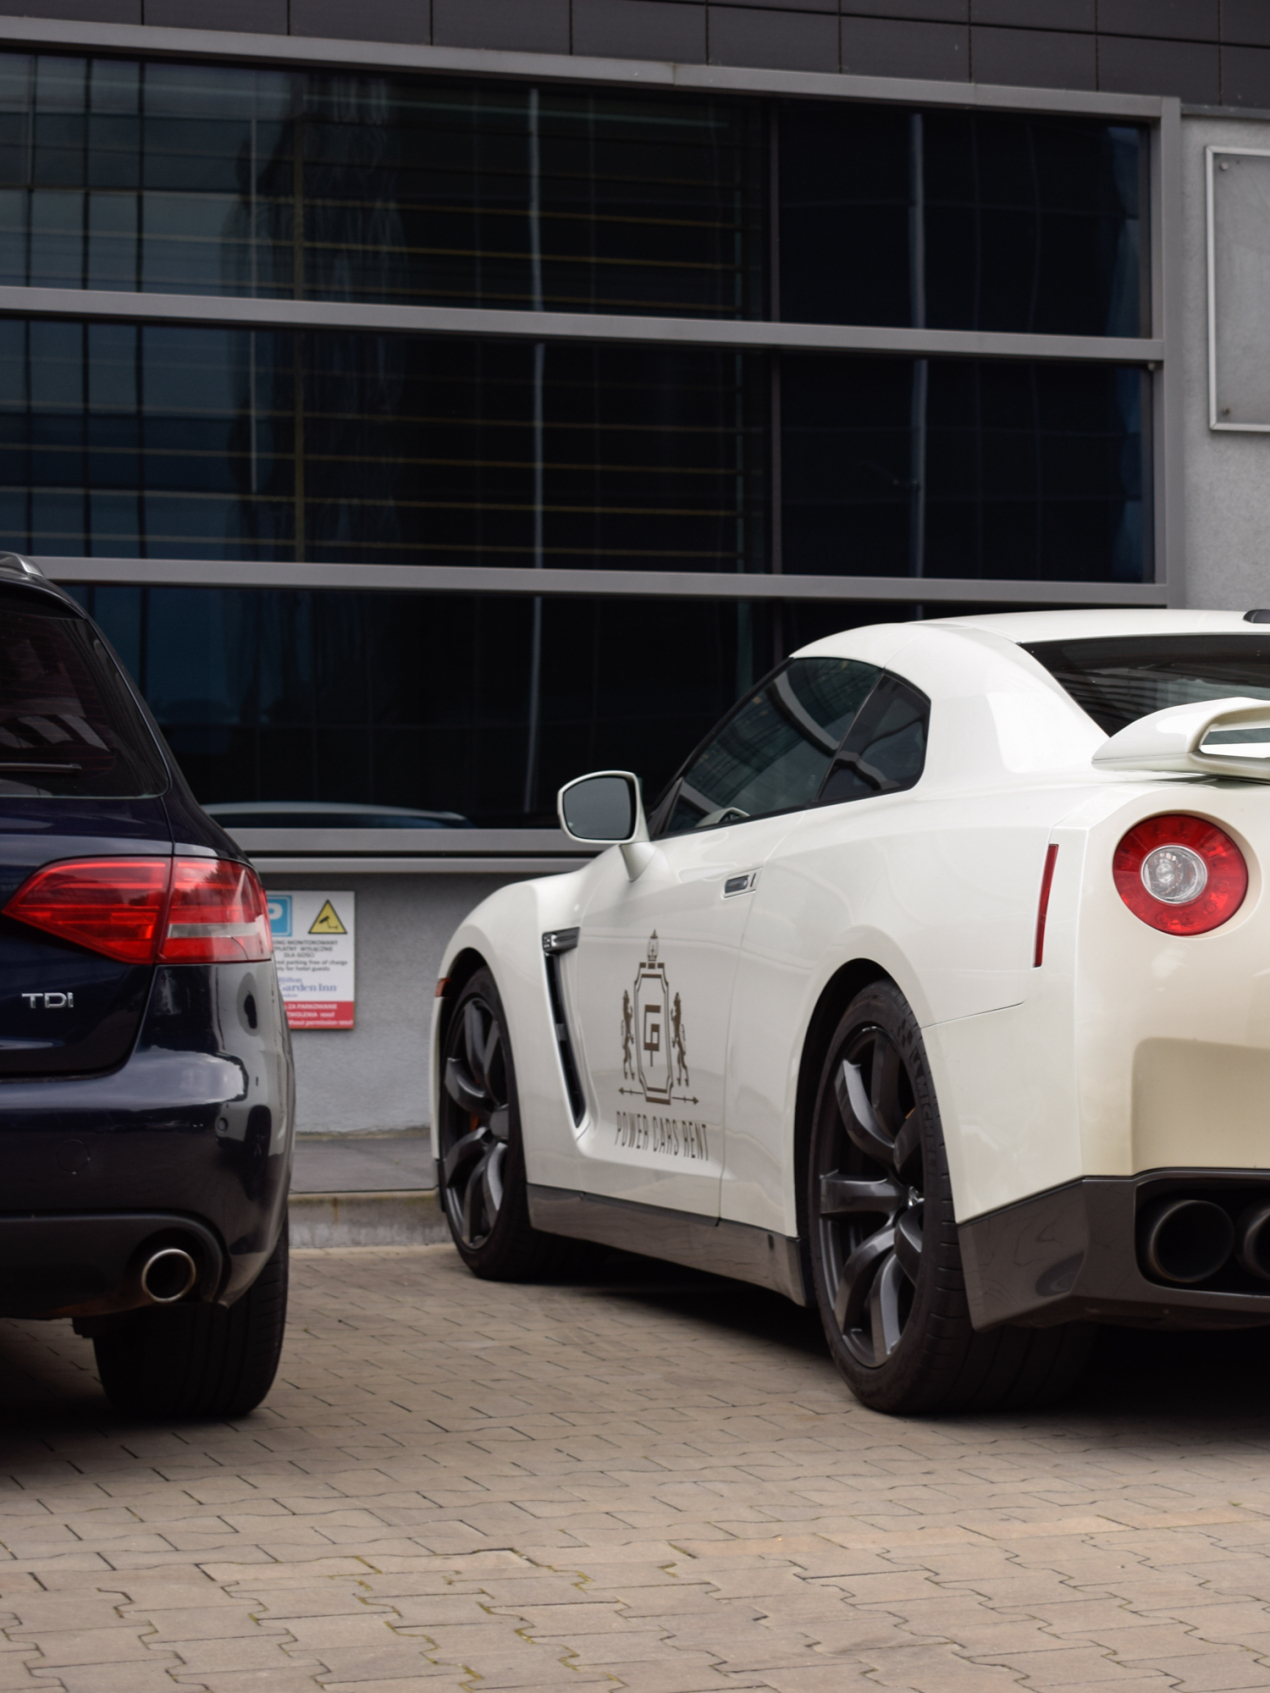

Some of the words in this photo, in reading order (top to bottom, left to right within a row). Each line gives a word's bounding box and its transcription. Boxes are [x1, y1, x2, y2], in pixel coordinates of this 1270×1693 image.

[318, 983, 337, 991] Inn
[21, 992, 75, 1009] TDI
[614, 1111, 649, 1151] POWER
[651, 1116, 680, 1156] CARS
[682, 1120, 709, 1161] RENT
